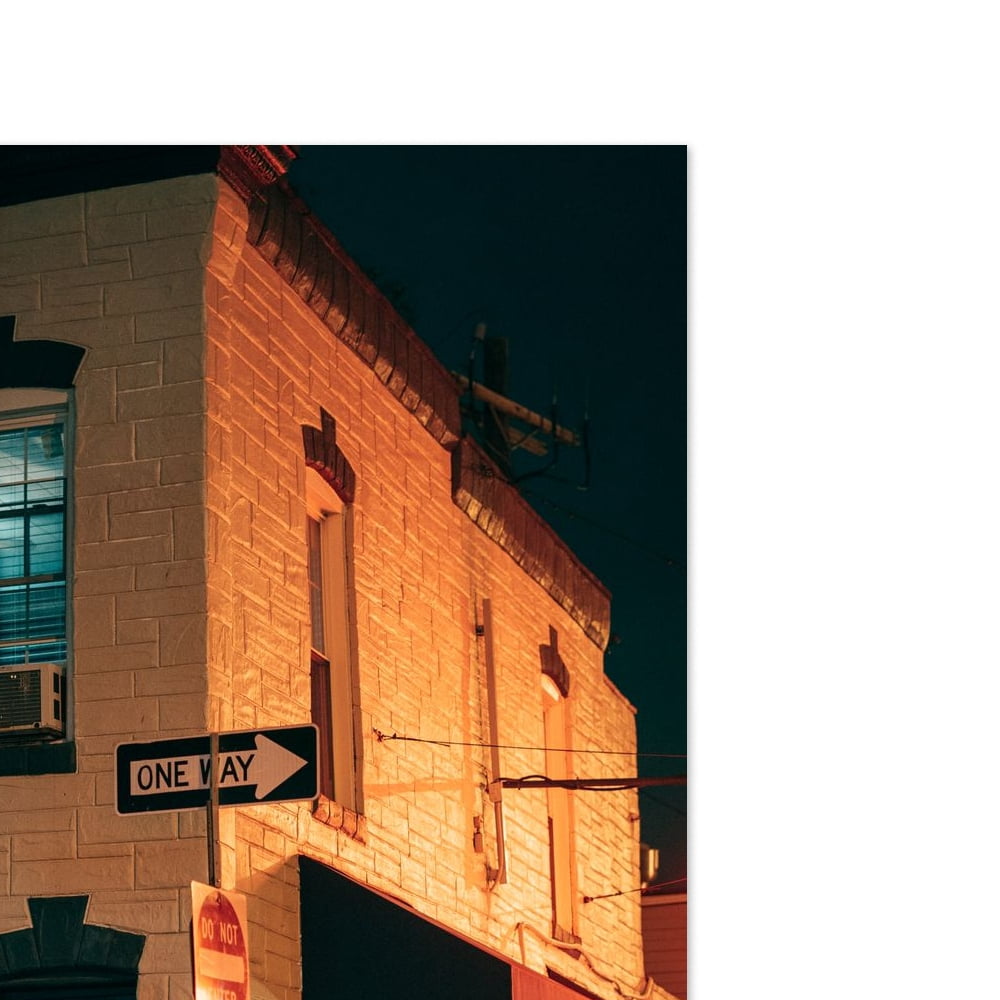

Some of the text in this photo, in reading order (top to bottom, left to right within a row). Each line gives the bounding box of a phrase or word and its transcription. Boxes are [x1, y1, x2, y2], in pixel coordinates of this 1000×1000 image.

[137, 754, 255, 791] ONE WAY
[201, 916, 238, 947] DO NOT
